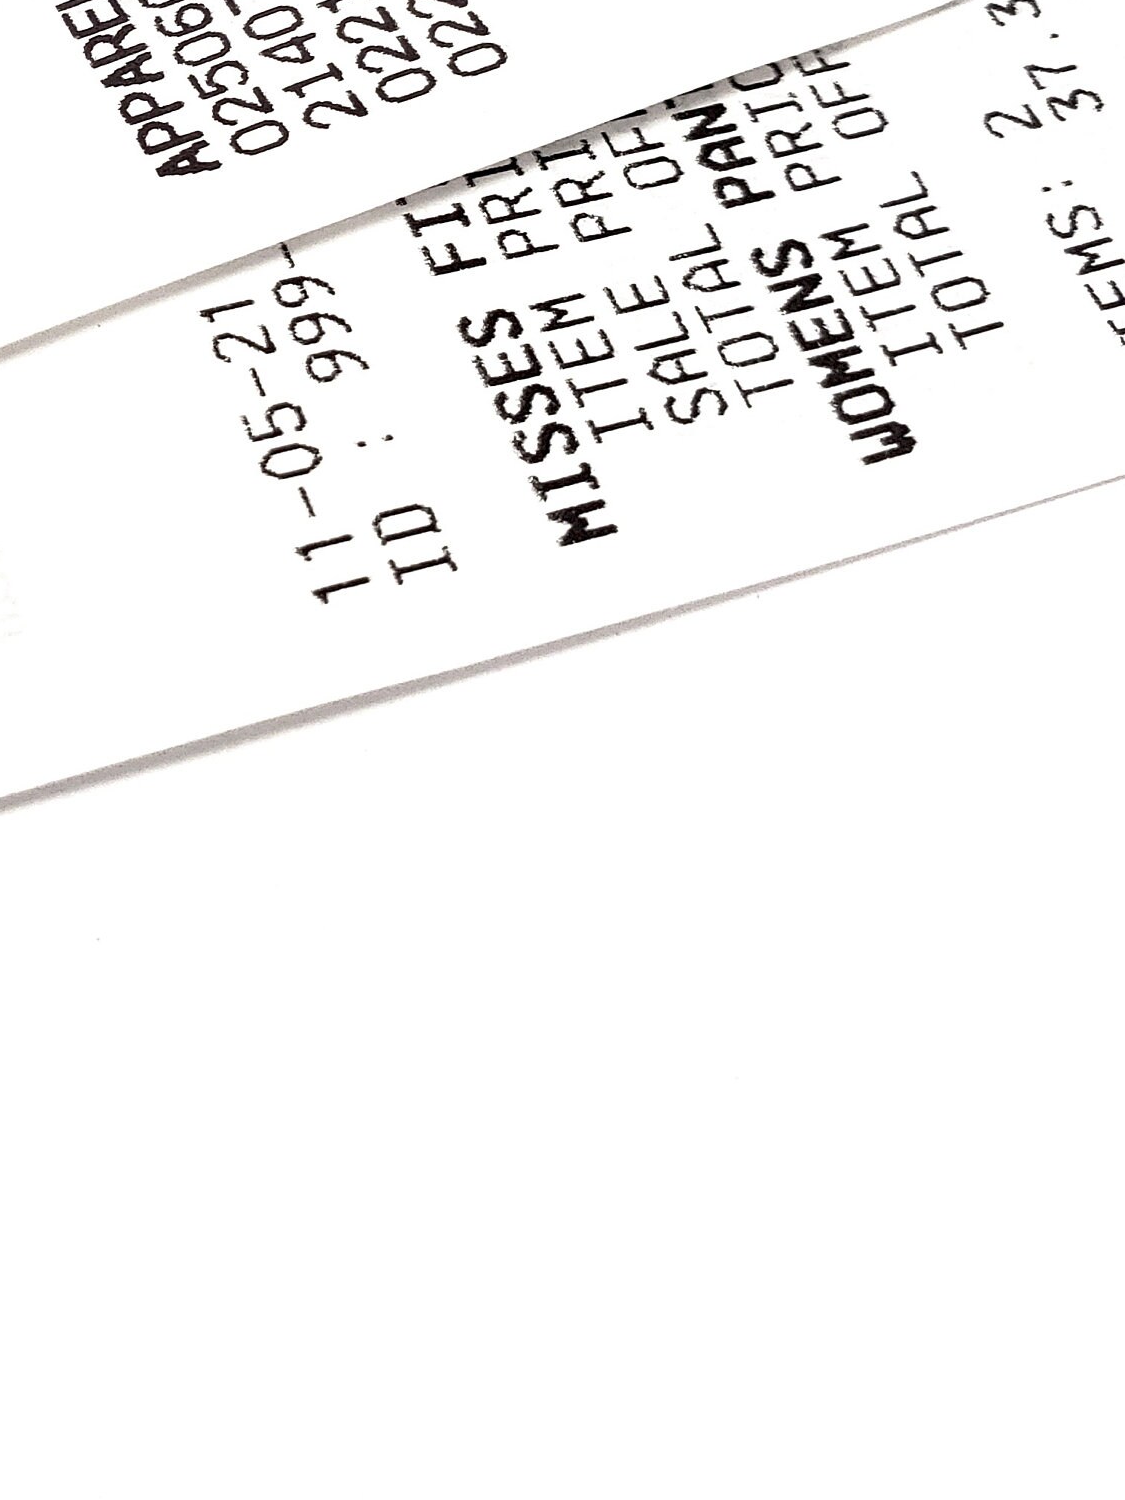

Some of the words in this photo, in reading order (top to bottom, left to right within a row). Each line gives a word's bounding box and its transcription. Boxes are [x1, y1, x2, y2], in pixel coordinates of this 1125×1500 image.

[601, 108, 684, 190] OF
[663, 82, 777, 209] PAN
[982, 102, 1044, 139] 2
[395, 180, 488, 277] FI
[819, 220, 941, 367] ITEM
[878, 170, 1006, 352] TOTAL
[529, 290, 653, 445] ITEM
[605, 273, 729, 426] SALE
[669, 222, 794, 409] TOTAL
[752, 240, 918, 466] WOMENS
[201, 298, 372, 606] 11-05-21
[457, 309, 619, 548] MISSES
[371, 502, 458, 585] ID
